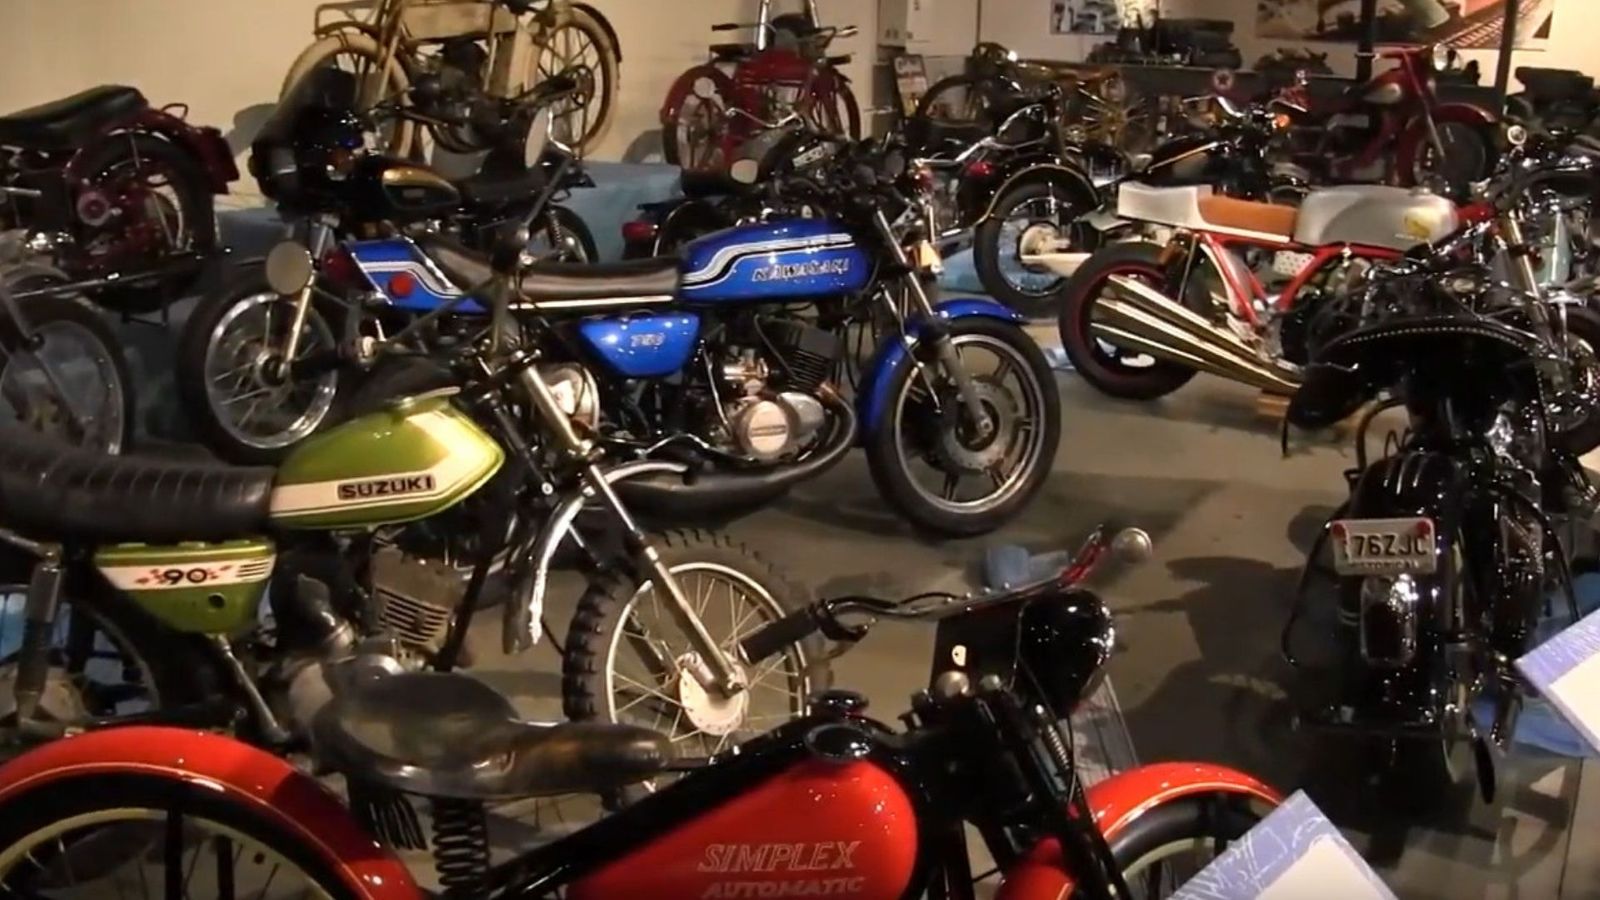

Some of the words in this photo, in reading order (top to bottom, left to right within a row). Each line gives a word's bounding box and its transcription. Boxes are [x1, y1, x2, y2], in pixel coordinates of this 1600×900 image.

[341, 475, 432, 499] SUZUKI
[163, 568, 207, 585] 90
[697, 840, 862, 873] SIMPLEX
[701, 876, 866, 899] AUTOMATIC
